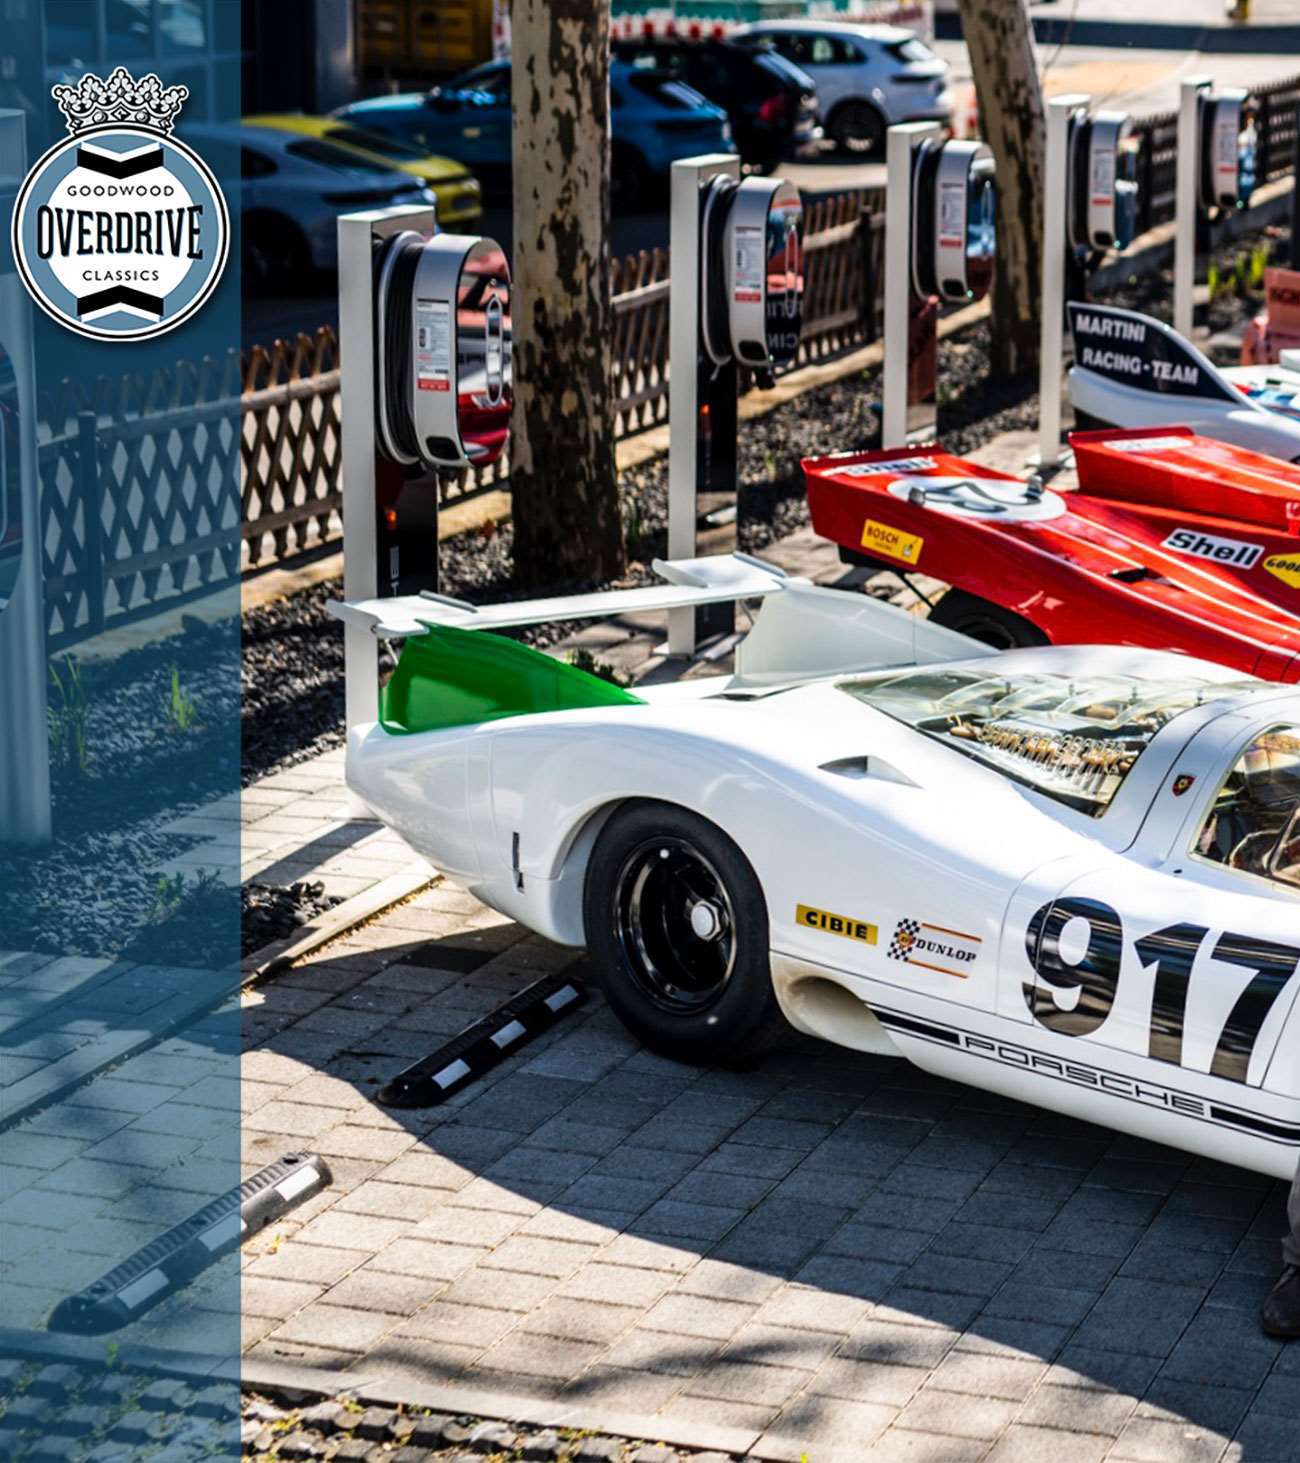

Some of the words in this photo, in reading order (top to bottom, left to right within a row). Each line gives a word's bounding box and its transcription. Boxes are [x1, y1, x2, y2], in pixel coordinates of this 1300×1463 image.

[1076, 314, 1146, 342] MARTINI
[866, 522, 900, 547] BOSCH
[1167, 532, 1259, 566] Shell
[805, 910, 868, 941] CIBIE
[915, 939, 977, 963] DUNLOP
[964, 1036, 1205, 1117] PORSCHE
